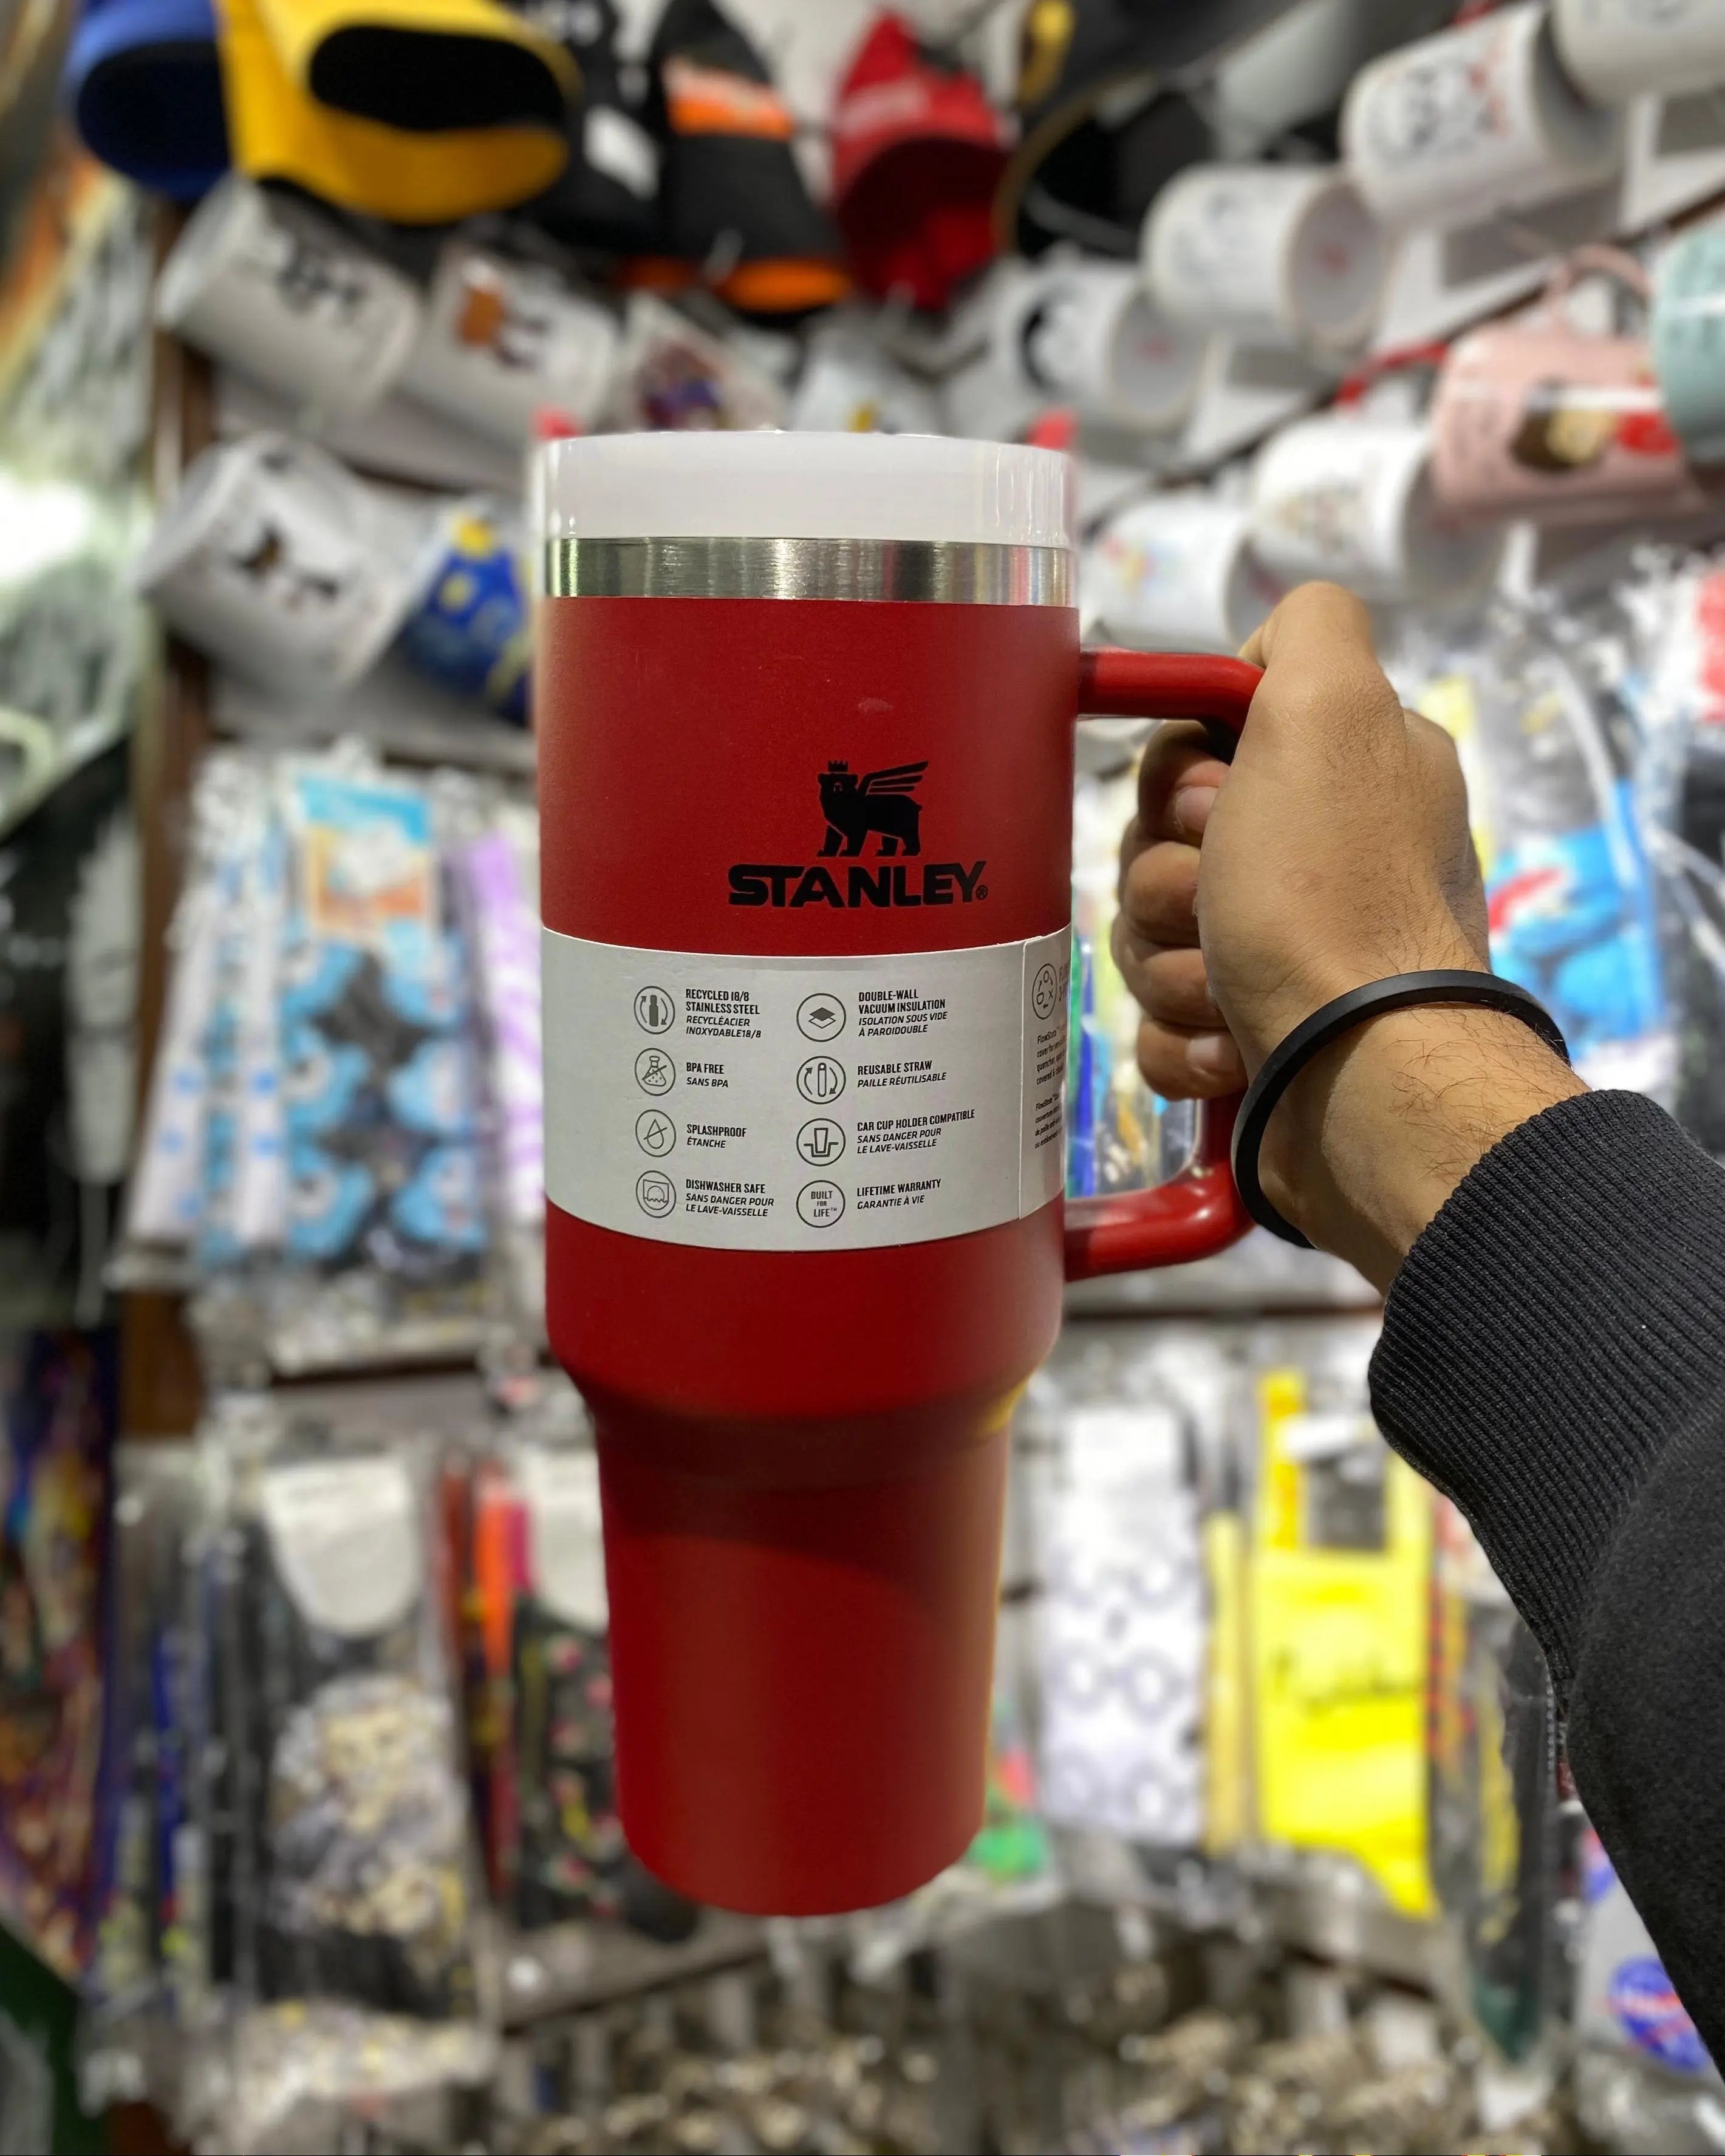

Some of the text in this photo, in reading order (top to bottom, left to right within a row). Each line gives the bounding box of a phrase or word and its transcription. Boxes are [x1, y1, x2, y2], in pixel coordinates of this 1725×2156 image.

[686, 989, 749, 1001] RECYCLED 18/8
[859, 989, 918, 1001] DOUBLE-WALL
[686, 1002, 760, 1015] STAINLESS STEEL
[859, 999, 946, 1014] VACUUM INSULATION
[859, 1012, 948, 1026] ISOLATION SOUS VIDE
[859, 1025, 928, 1037] À PAROIDOUBLE
[686, 1063, 724, 1074] BPA FREE
[858, 1060, 932, 1076] REUSABLE STRAW
[686, 1077, 728, 1088] SANS BPA
[858, 1073, 946, 1088] PAILLE RÉUTILISABLE
[857, 1109, 975, 1131] CAR CUP HOLDER COMPATIBLE
[687, 1124, 746, 1137] SPLASHPROOF
[857, 1128, 941, 1143] SANS DANGER POUR
[687, 1136, 726, 1148] ÉTANCHE
[857, 1139, 937, 1154] LE LAVE-VAISSELLE
[686, 1179, 765, 1193] DISHWASHER SAFE
[857, 1179, 941, 1196] LIFETIME WARRANTY
[686, 1193, 708, 1202] SANS
[711, 1195, 746, 1205] DANGER
[811, 1191, 833, 1199] BUILT
[857, 1195, 924, 1209] GARANTIE À VIE
[698, 1205, 768, 1216] LAVE-VAISSELLE
